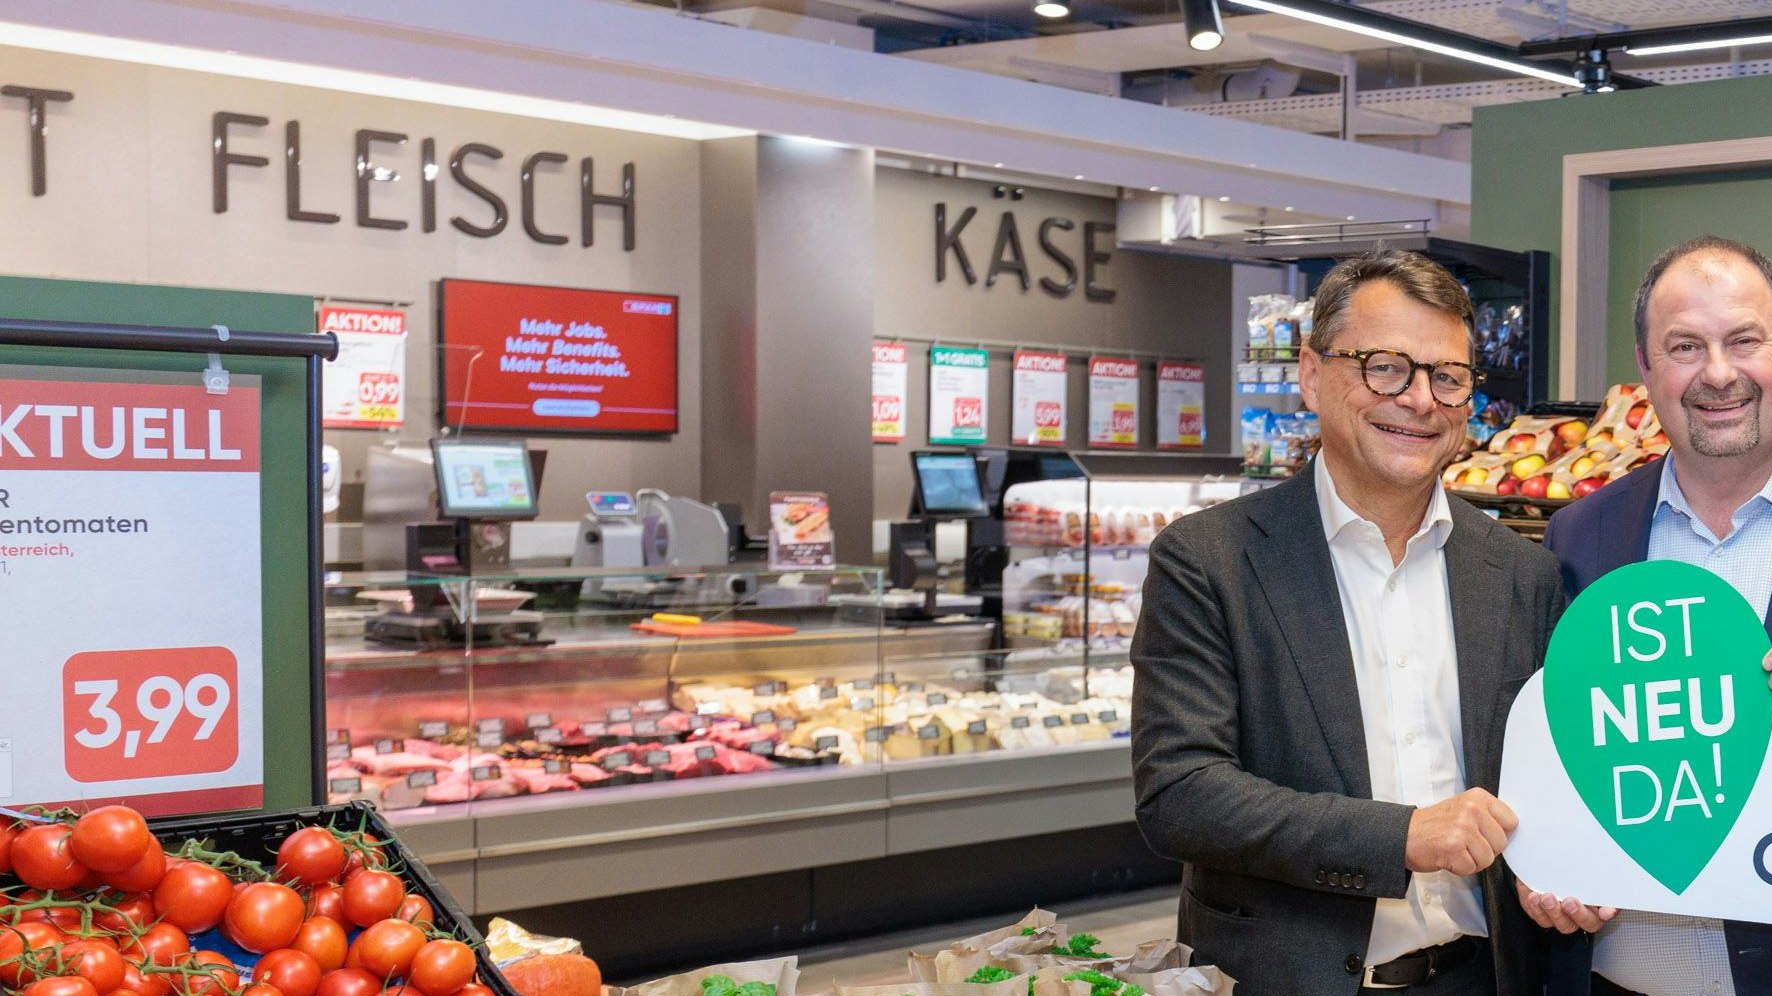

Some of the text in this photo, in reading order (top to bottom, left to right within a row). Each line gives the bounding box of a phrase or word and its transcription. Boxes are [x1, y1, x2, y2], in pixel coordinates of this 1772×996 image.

[213, 110, 636, 252] FLEISCH
[934, 185, 1117, 303] KÄSE
[324, 311, 402, 333] AKTION!
[520, 318, 607, 339] Mehr Jobs.
[505, 336, 621, 358] Mehr Benefits.
[500, 355, 630, 378] Mehr Sicherheit.
[951, 353, 985, 367] GRATIS
[1017, 354, 1066, 371] AKTION!
[1093, 361, 1138, 377] AKTION!
[1160, 366, 1203, 381] AKTION!
[1611, 596, 1706, 662] IST
[74, 673, 231, 758] 3,99
[1591, 674, 1737, 747] NEU
[1612, 743, 1725, 827] DA!
